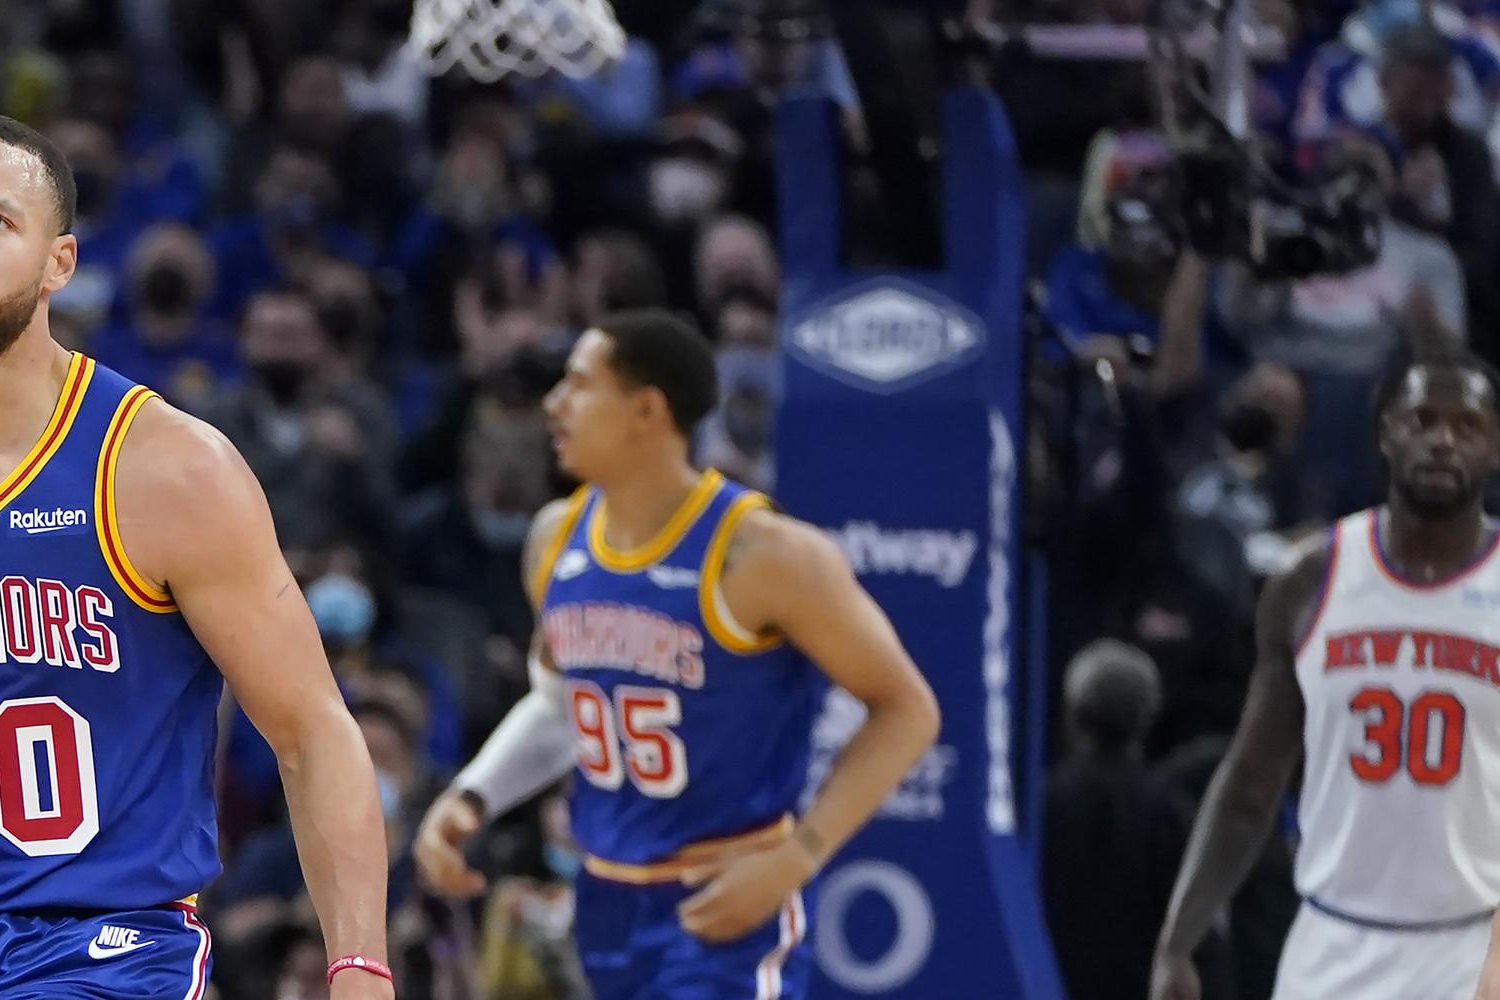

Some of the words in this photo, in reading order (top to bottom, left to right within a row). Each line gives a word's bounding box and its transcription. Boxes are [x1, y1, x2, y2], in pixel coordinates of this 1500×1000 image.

[9, 507, 87, 529] Rakuten
[843, 518, 979, 588] tway
[542, 601, 705, 690] WARRIORS
[1324, 627, 1404, 676] NEW
[568, 680, 688, 799] 95
[1349, 686, 1466, 788] 30
[97, 925, 140, 947] NIKE
